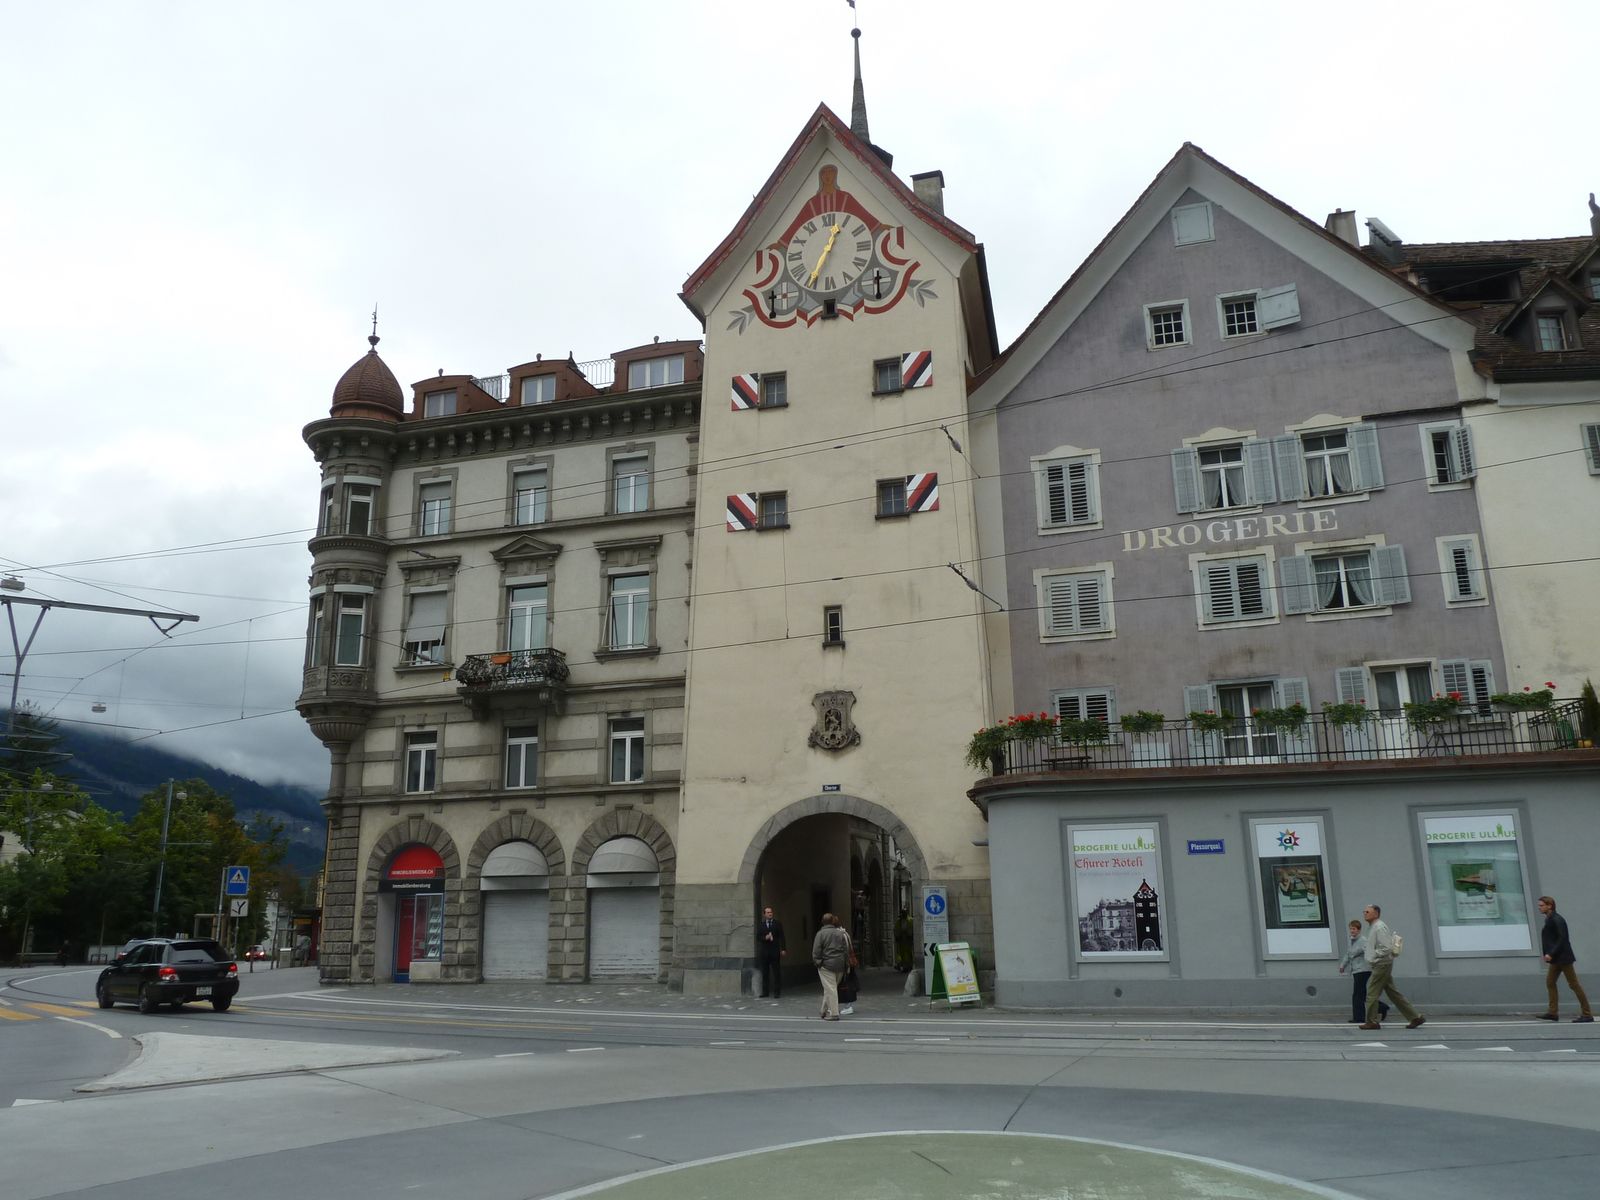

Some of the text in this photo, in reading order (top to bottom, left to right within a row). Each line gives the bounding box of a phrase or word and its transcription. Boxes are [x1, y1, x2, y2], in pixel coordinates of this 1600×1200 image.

[1121, 508, 1339, 552] DROGERIE
[1283, 836, 1293, 845] d
[1427, 832, 1477, 841] DROGERIE
[1073, 843, 1120, 852] DROGERIE
[1074, 857, 1110, 870] Churer
